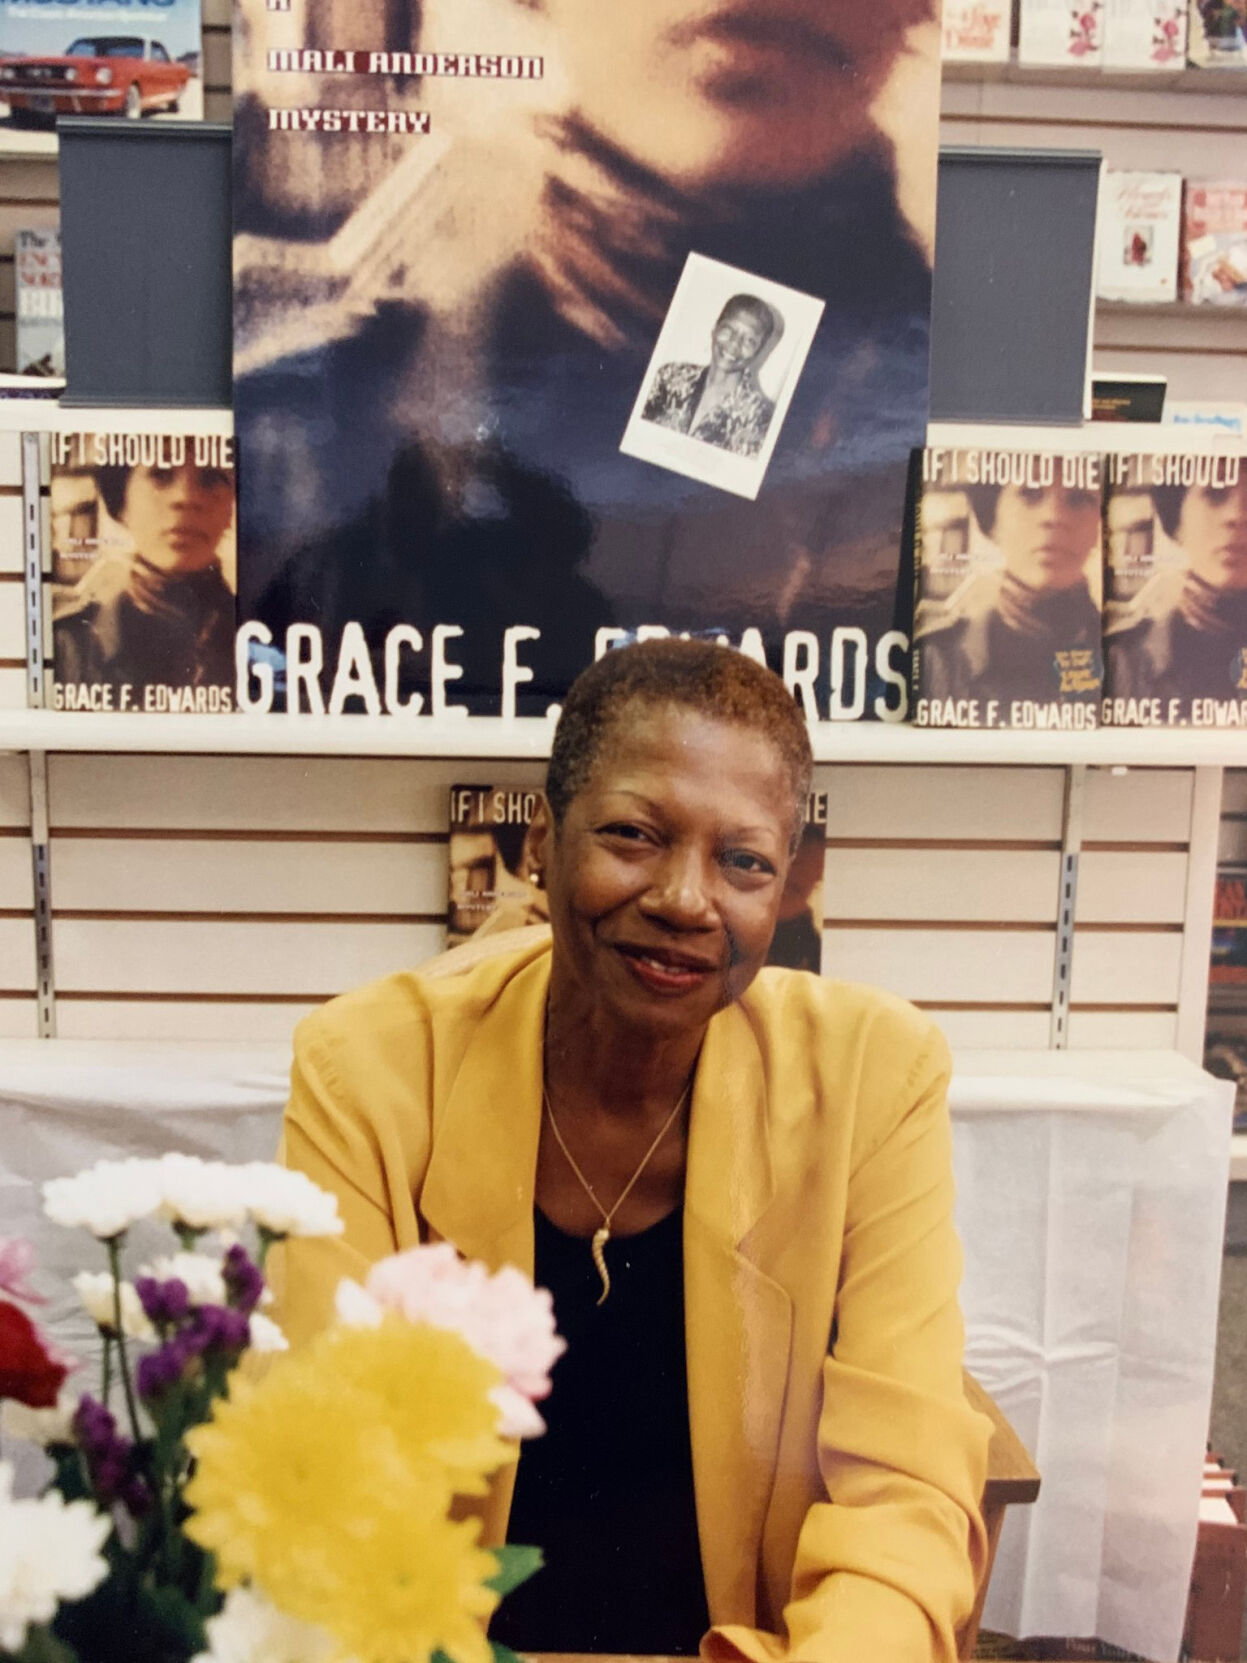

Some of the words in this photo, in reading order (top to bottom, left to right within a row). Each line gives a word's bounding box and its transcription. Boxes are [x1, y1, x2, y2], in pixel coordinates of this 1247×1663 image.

[268, 50, 355, 72] MALI
[368, 52, 543, 79] ANDERSON
[268, 109, 429, 133] MYSTERY
[51, 433, 73, 466] IF
[79, 433, 85, 466] I
[94, 433, 186, 469] SHOULD
[195, 435, 234, 469] DIE
[922, 449, 944, 482] IF
[951, 450, 958, 482] I
[966, 451, 1054, 488] SHOULD
[1062, 454, 1100, 489] DIE
[1109, 453, 1129, 483] IF
[1136, 453, 1143, 484] I
[1152, 453, 1240, 488] SHOULD
[235, 620, 469, 716] GRACE
[53, 683, 112, 710] GRACE
[144, 684, 233, 713] EDWARDS
[916, 698, 980, 727] GRACE
[1011, 700, 1097, 730] EDWARDS
[1101, 698, 1162, 725] GRACE
[1191, 698, 1247, 726] EDWA
[451, 790, 472, 823] IF
[479, 792, 485, 823] I
[493, 791, 536, 825] SHO
